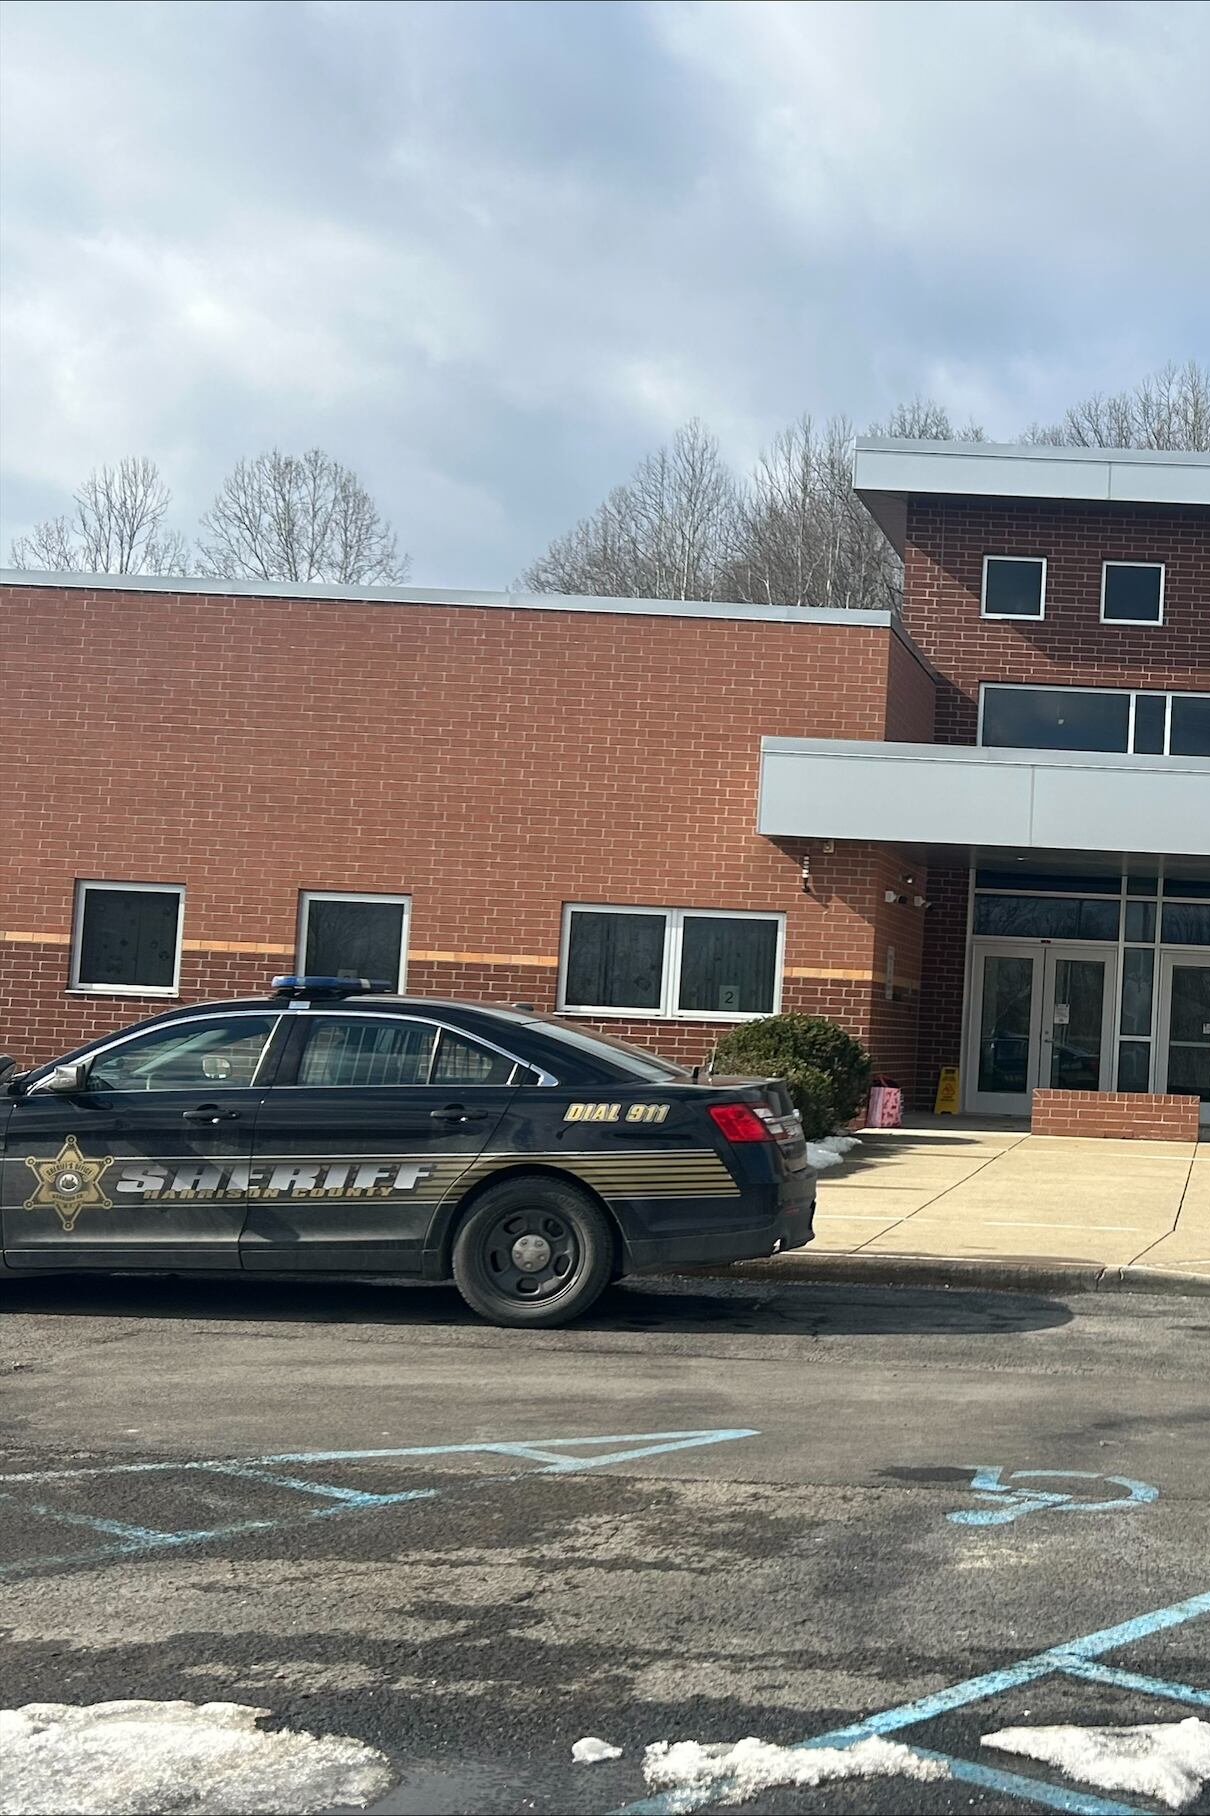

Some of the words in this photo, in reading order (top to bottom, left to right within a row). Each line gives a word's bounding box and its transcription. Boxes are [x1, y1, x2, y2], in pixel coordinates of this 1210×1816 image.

[724, 991, 734, 1004] 2
[563, 1103, 622, 1122] DIAL
[625, 1104, 671, 1123] 911
[116, 1163, 433, 1192] SHERIFF
[143, 1188, 280, 1199] HARRISON
[291, 1187, 393, 1198] COUNTY
